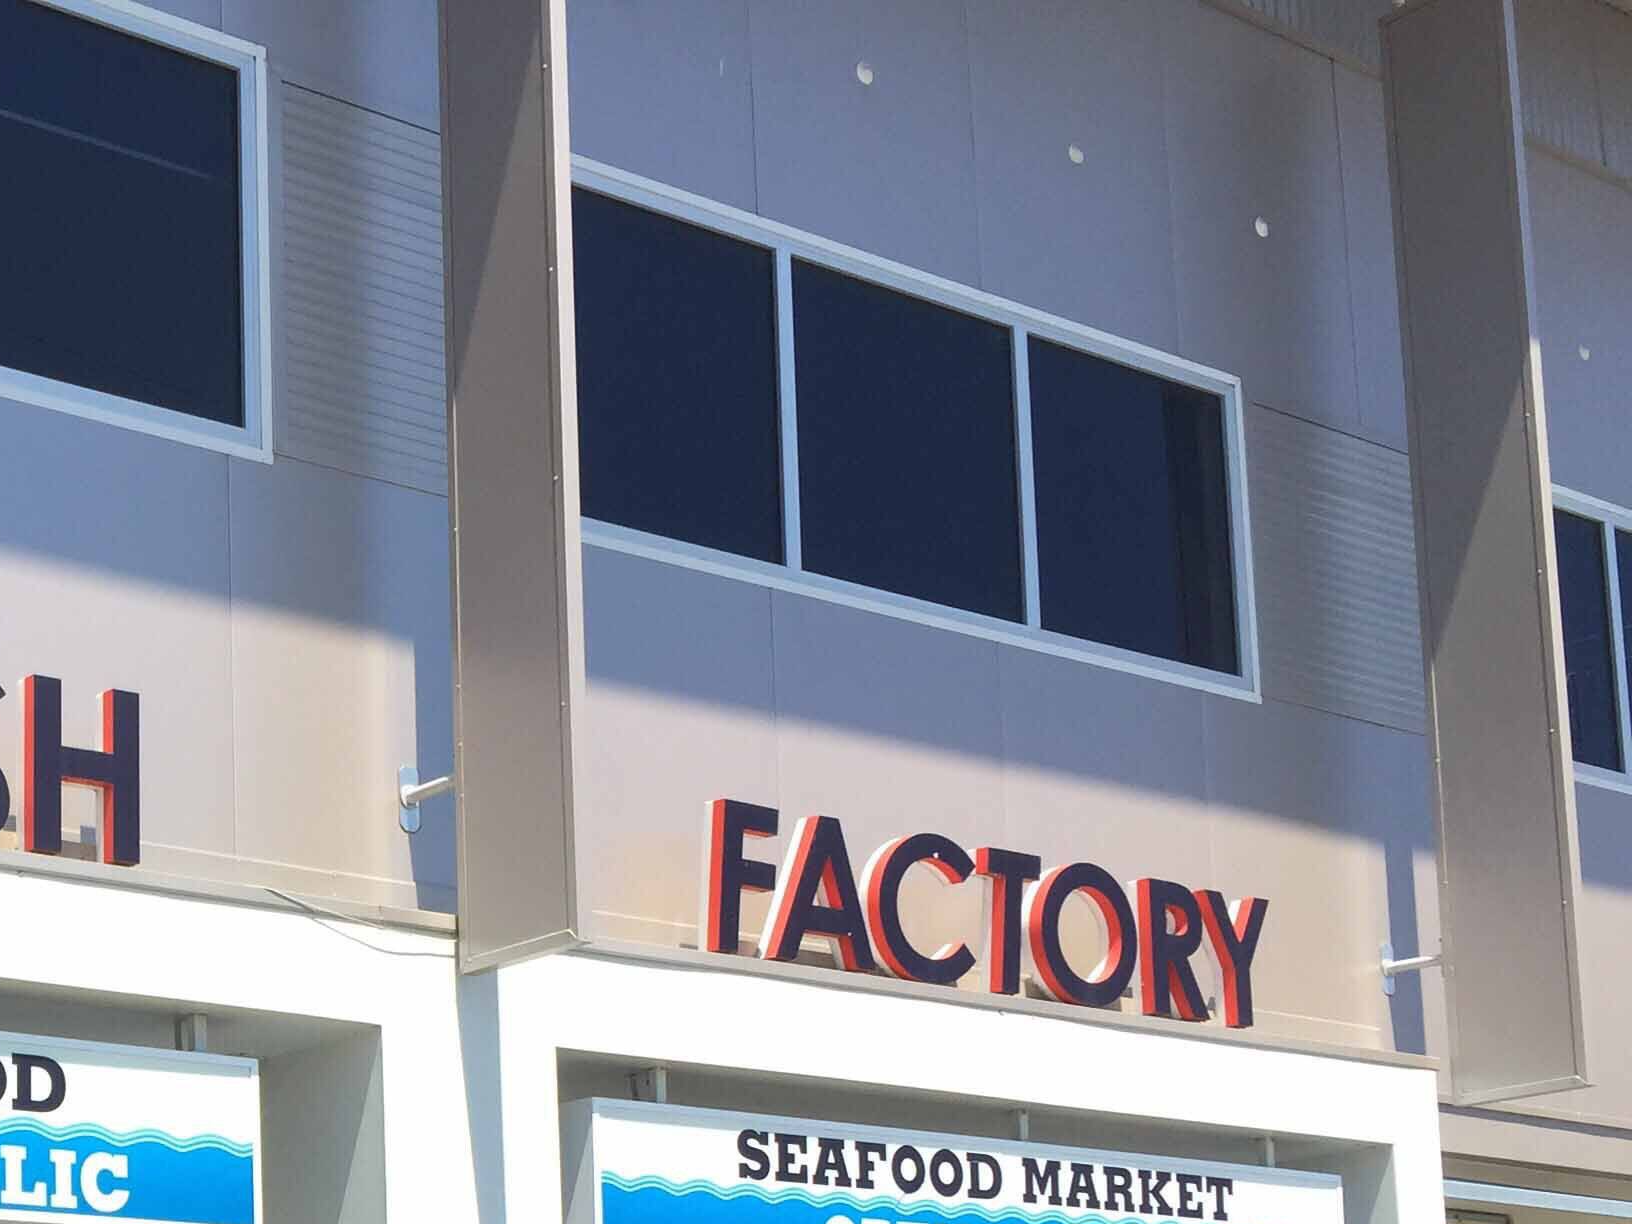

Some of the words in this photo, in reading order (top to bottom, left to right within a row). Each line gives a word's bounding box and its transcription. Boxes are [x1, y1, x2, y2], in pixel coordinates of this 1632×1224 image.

[706, 798, 1269, 1028] FACTORY
[736, 1128, 1003, 1199] SEAFOOD
[1022, 1158, 1234, 1222] MARKET
